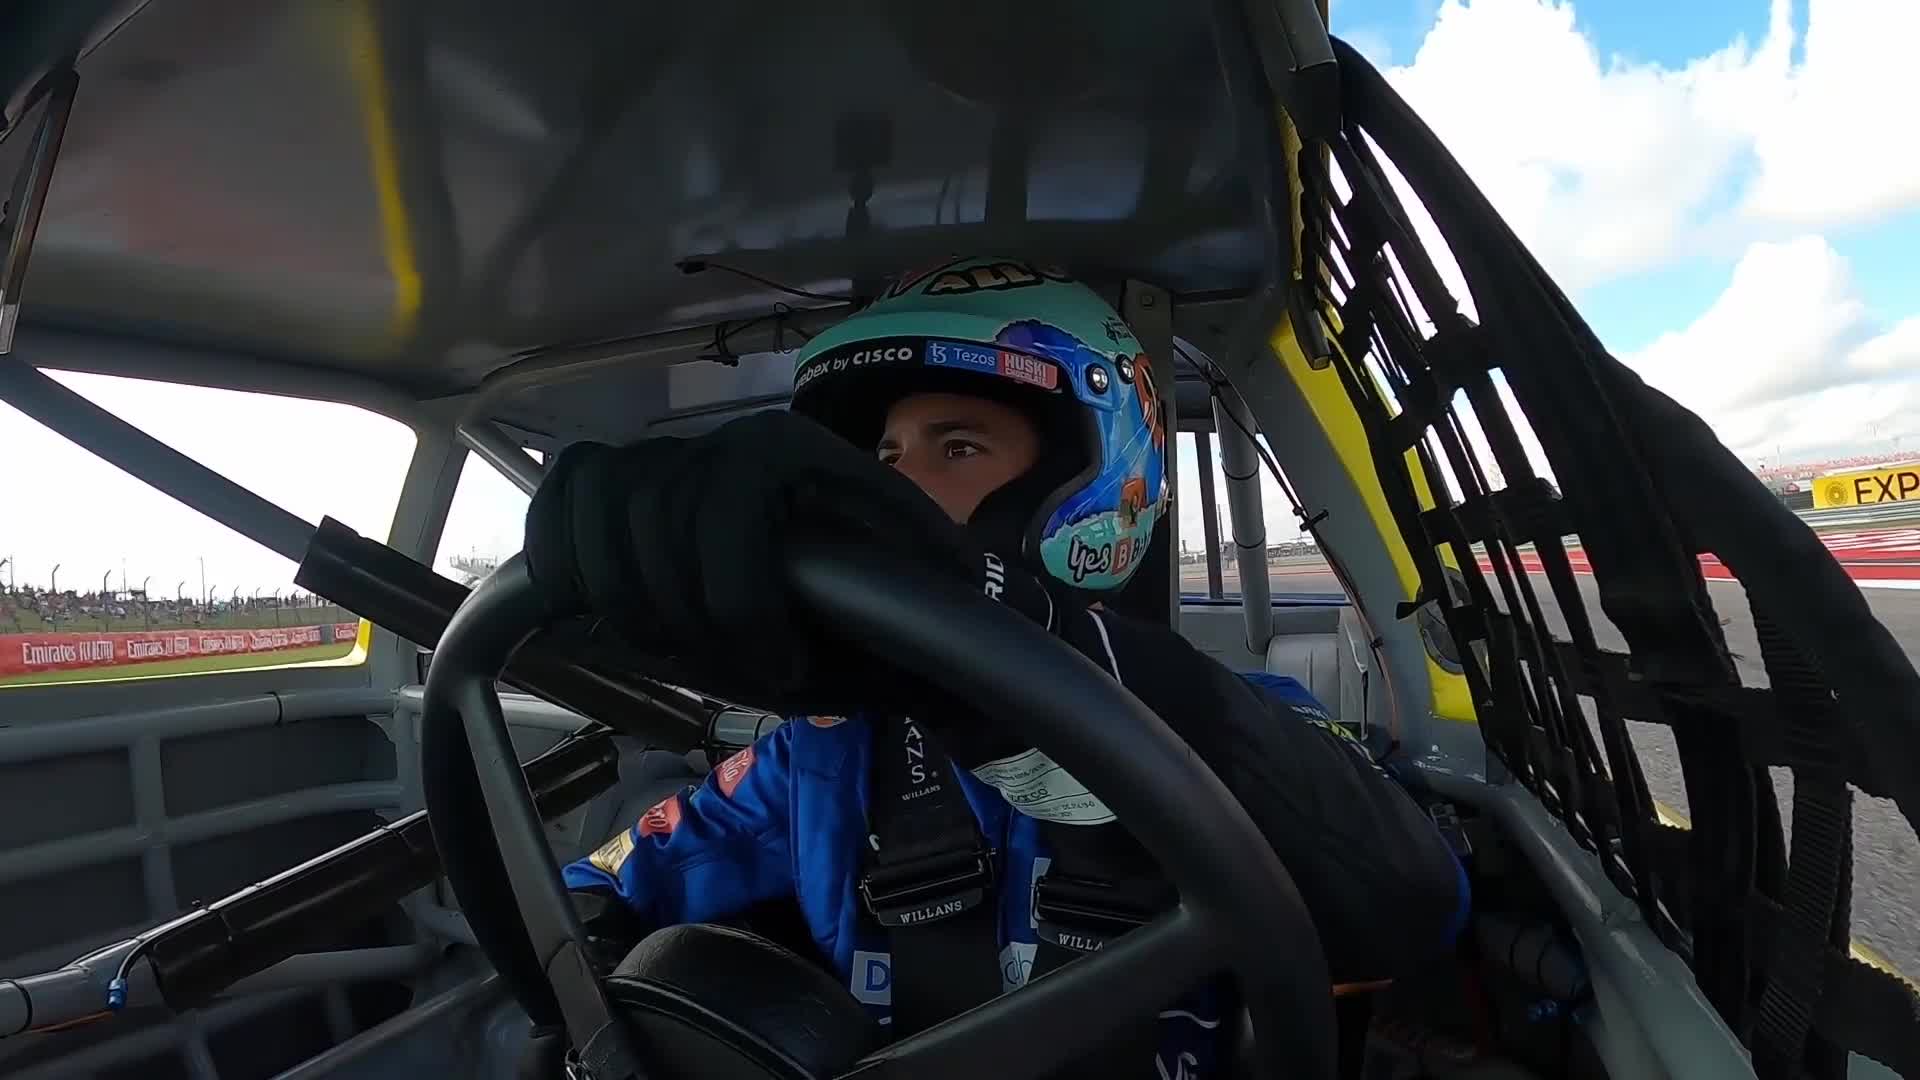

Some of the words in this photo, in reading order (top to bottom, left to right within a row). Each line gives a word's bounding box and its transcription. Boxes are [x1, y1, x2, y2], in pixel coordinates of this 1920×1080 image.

[832, 357, 850, 370] by
[852, 347, 913, 365] CISCO
[953, 348, 996, 367] Tezos
[1004, 353, 1047, 378] HUSKI
[1854, 472, 1920, 505] EXP
[22, 641, 77, 665] Emirates
[903, 716, 927, 784] ANS
[901, 784, 941, 801] WILLANS
[899, 900, 963, 924] WILLANS
